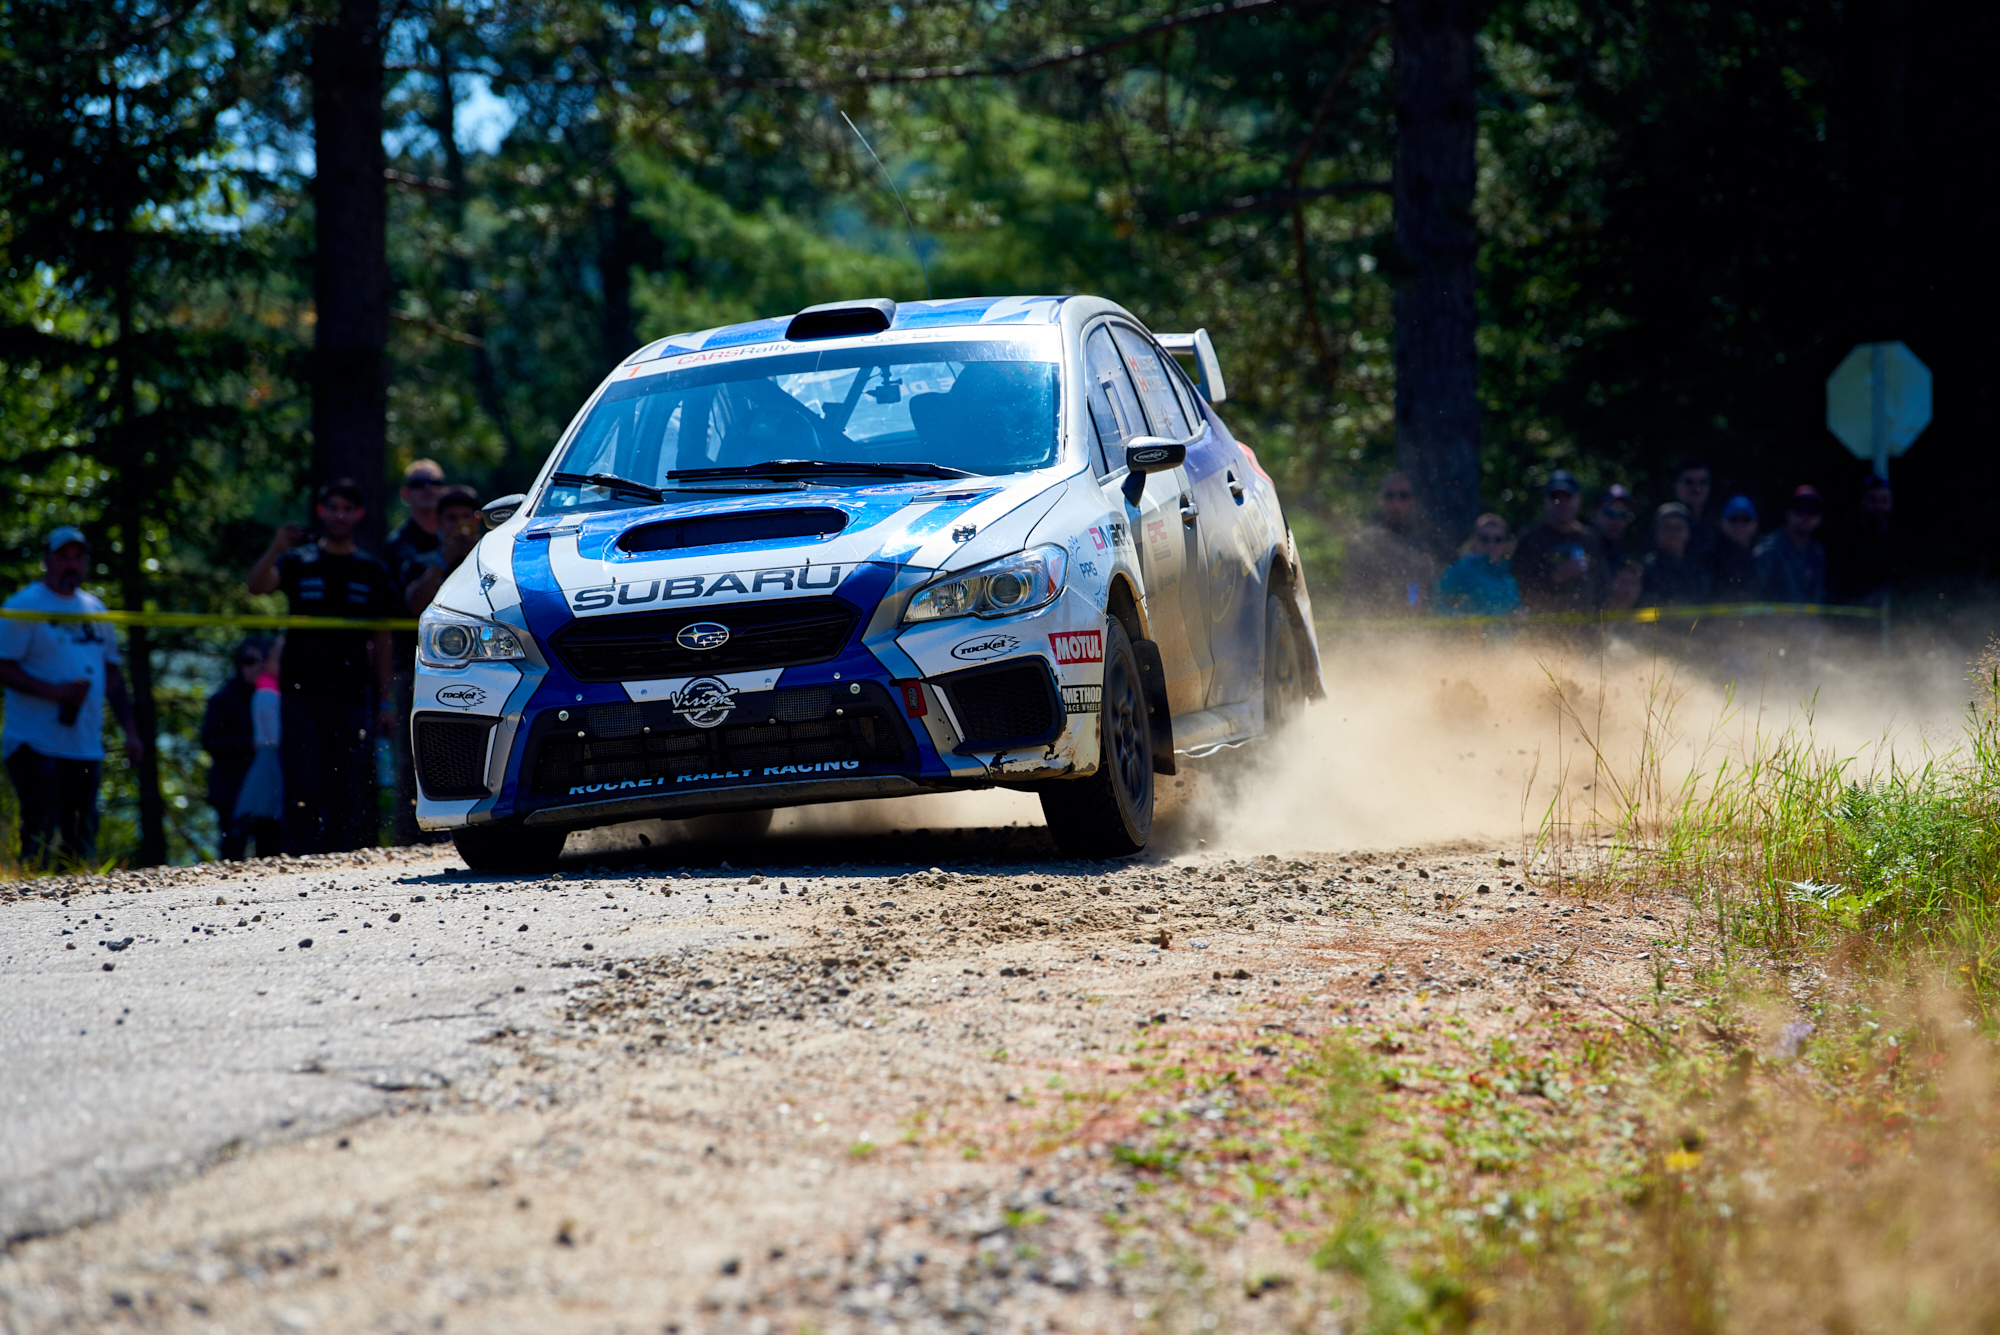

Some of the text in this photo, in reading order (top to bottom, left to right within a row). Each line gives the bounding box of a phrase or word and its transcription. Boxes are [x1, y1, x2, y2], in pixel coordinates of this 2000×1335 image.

[1079, 561, 1098, 578] PPG
[572, 565, 841, 612] SUBARU
[1055, 634, 1102, 660] MOTUL
[671, 691, 736, 708] Vision
[1062, 686, 1102, 704] METHOD
